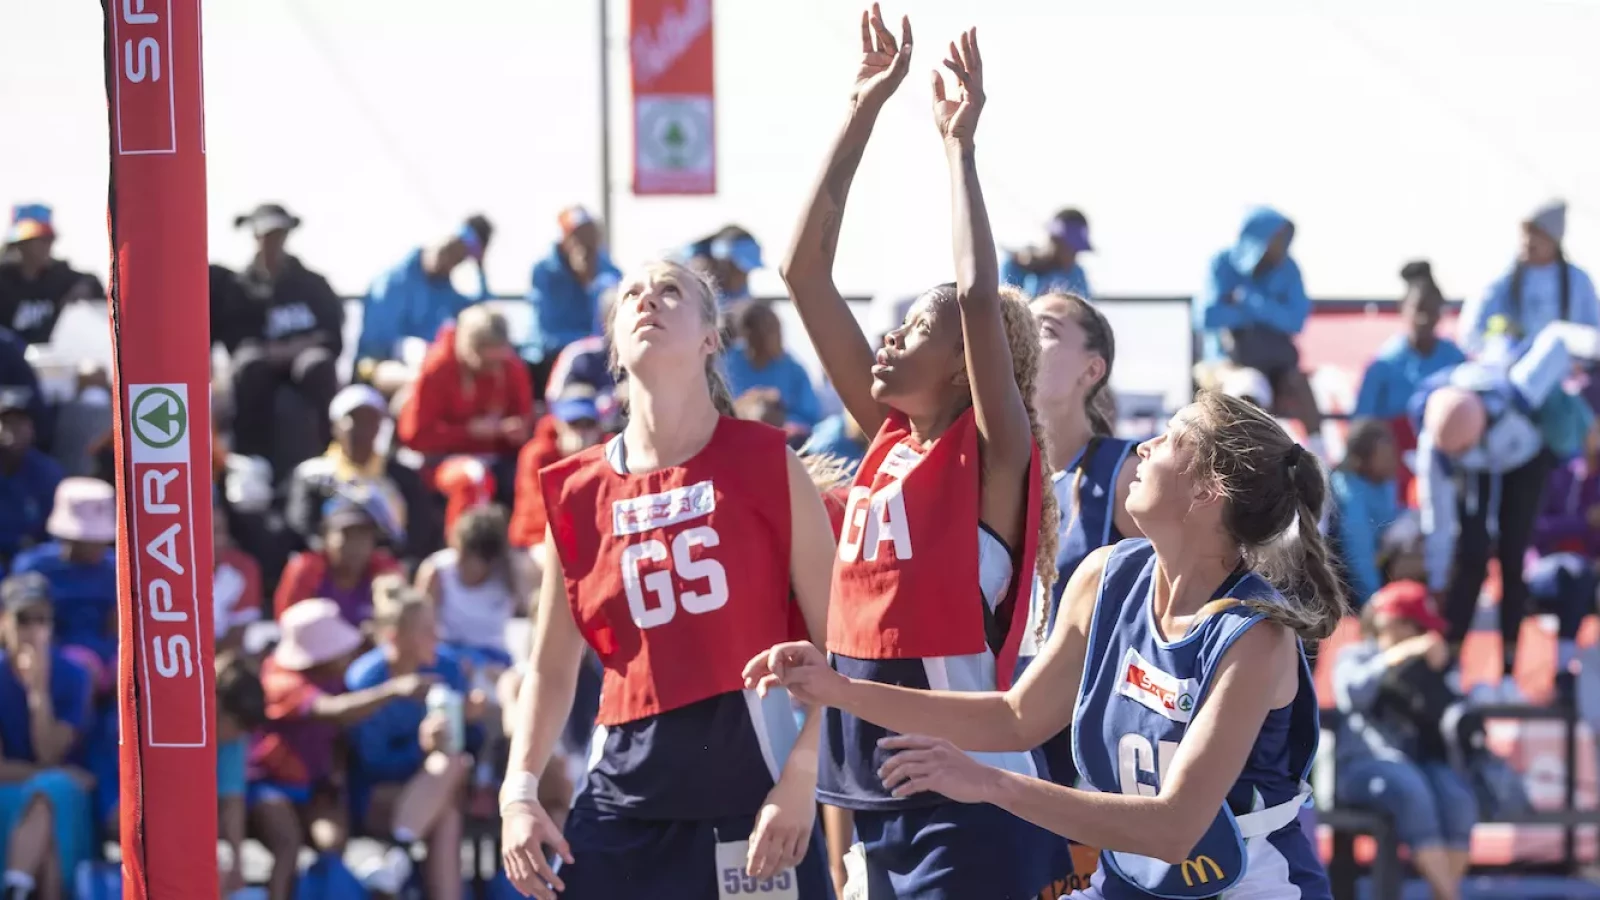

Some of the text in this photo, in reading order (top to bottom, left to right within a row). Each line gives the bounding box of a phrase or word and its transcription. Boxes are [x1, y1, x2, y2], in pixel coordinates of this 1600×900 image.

[838, 485, 913, 562] GA
[143, 468, 194, 678] SPAR
[620, 525, 729, 629] GS
[1118, 733, 1180, 797] G
